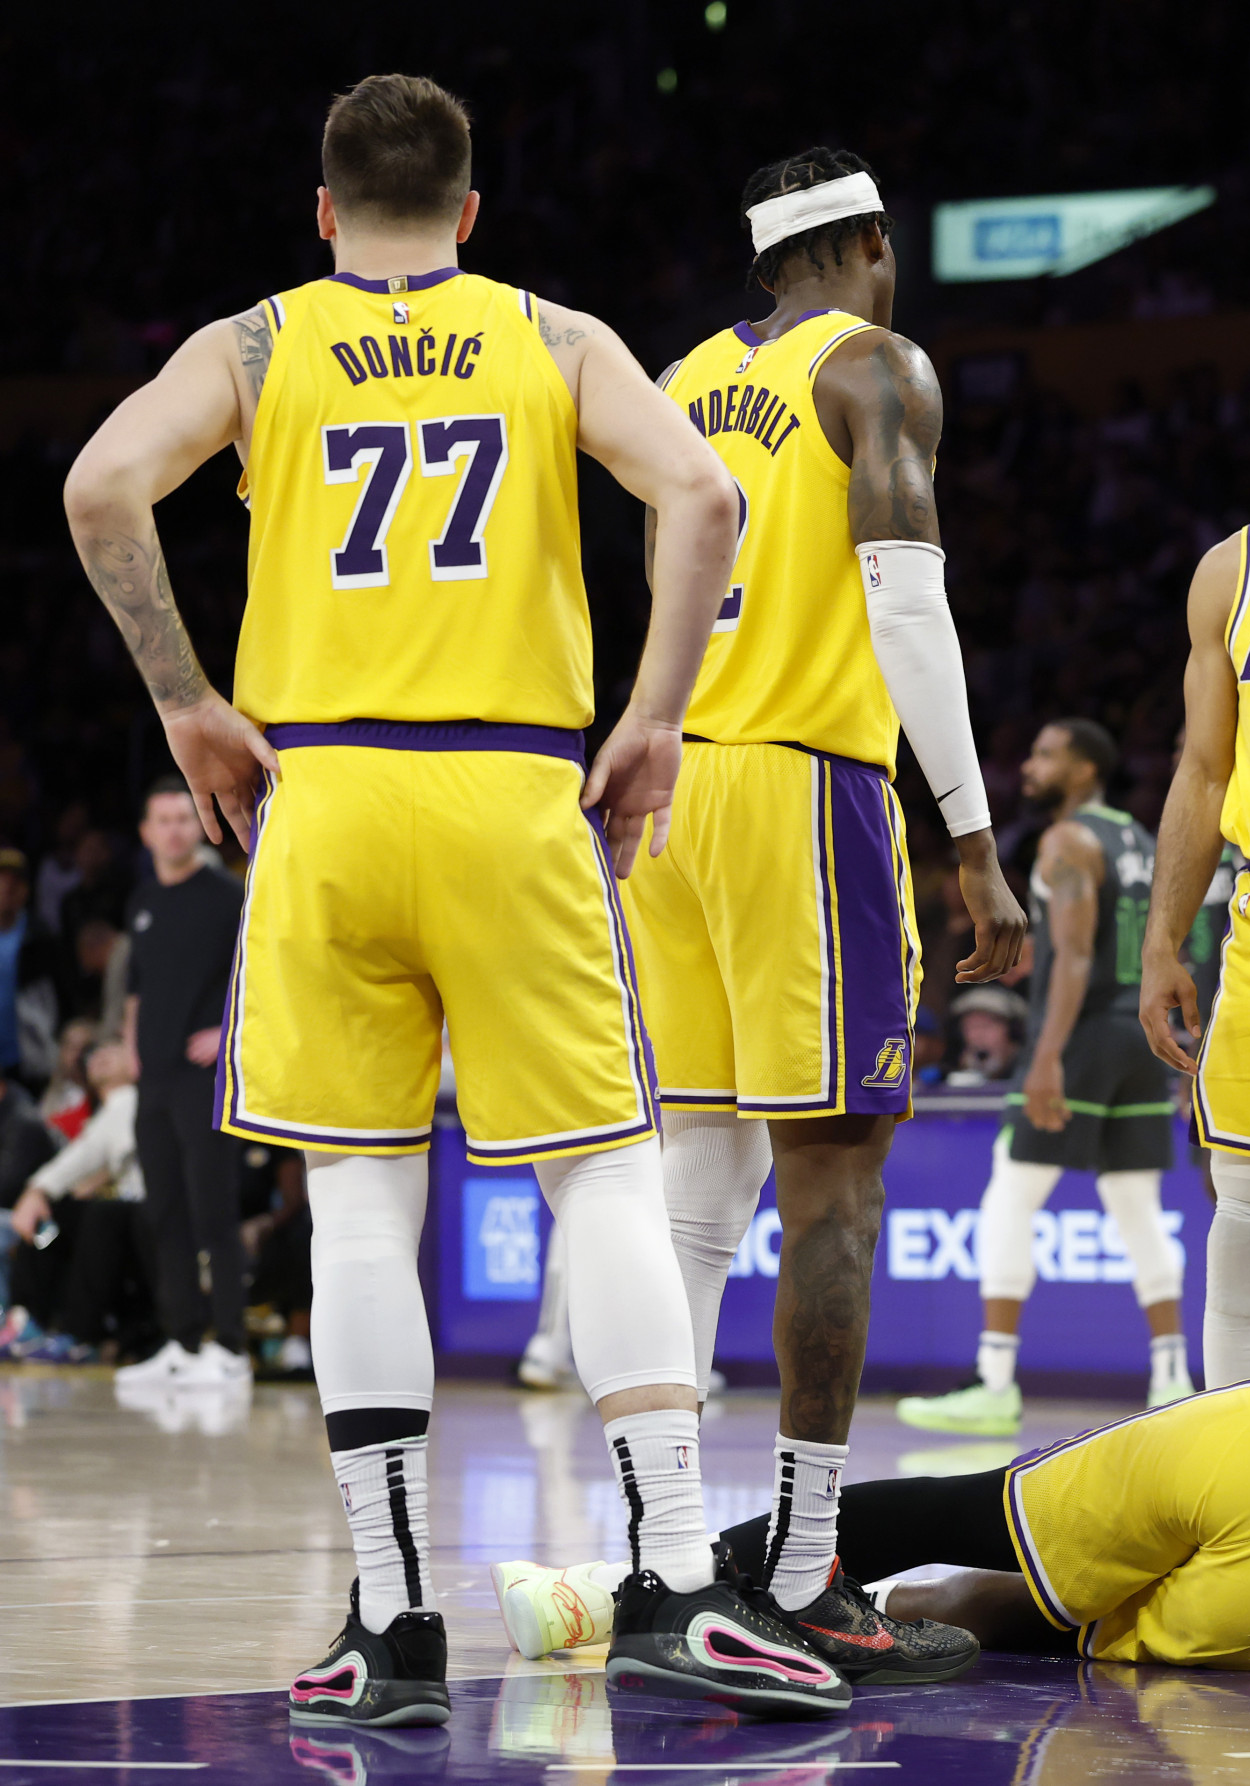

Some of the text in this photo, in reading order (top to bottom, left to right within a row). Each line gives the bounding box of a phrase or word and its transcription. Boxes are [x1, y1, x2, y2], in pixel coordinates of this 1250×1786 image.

[330, 326, 485, 386] DONČIĆ
[688, 384, 801, 457] NDERBILT
[320, 413, 509, 590] 77
